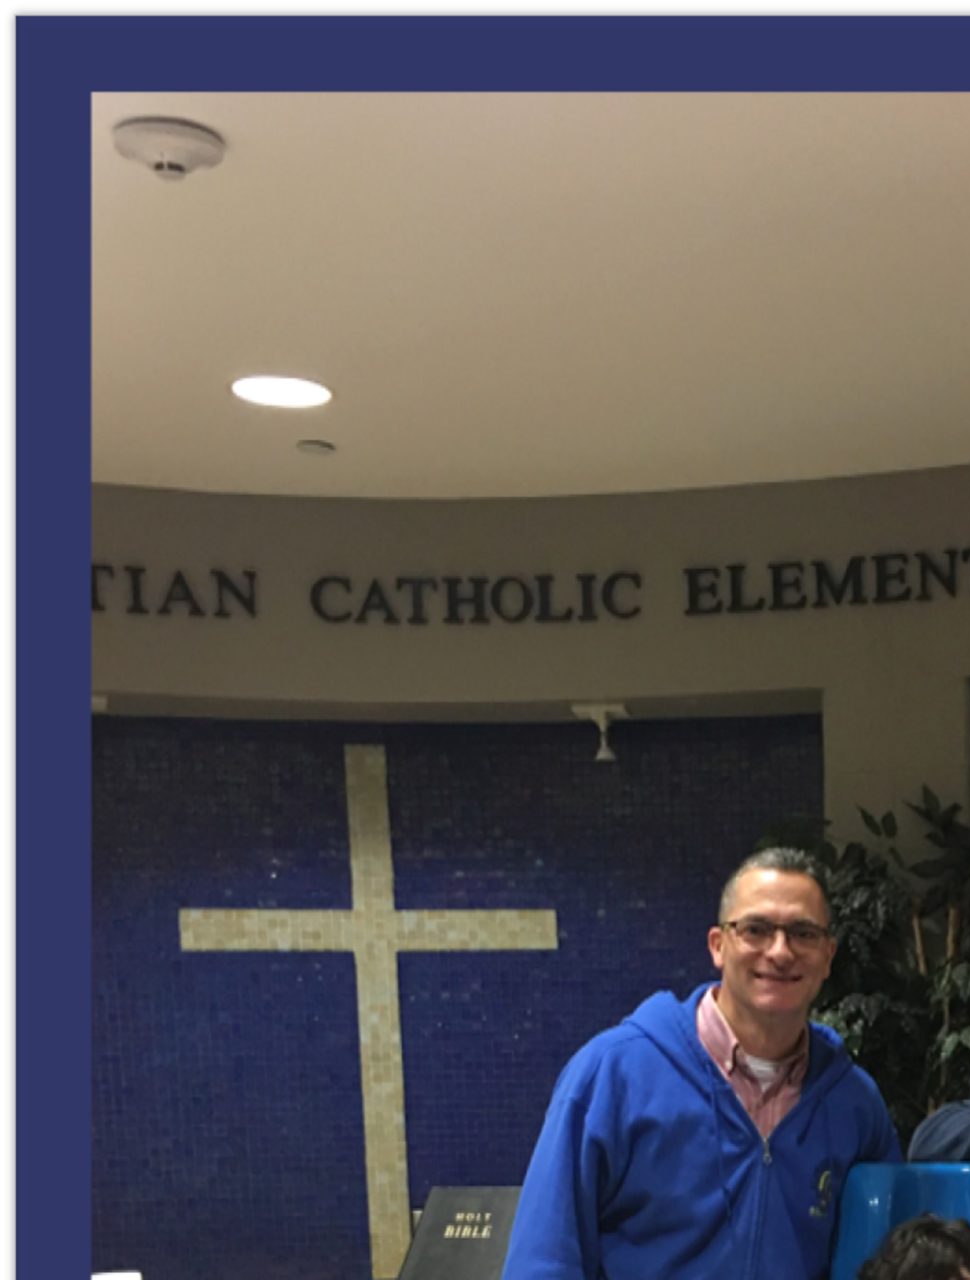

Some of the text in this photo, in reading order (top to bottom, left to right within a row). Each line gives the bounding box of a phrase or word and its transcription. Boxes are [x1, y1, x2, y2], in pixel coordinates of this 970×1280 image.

[92, 564, 257, 619] TIAN
[309, 571, 643, 625] CATHOLIC
[455, 1212, 492, 1221] HOLY
[443, 1224, 492, 1239] BIBLE
